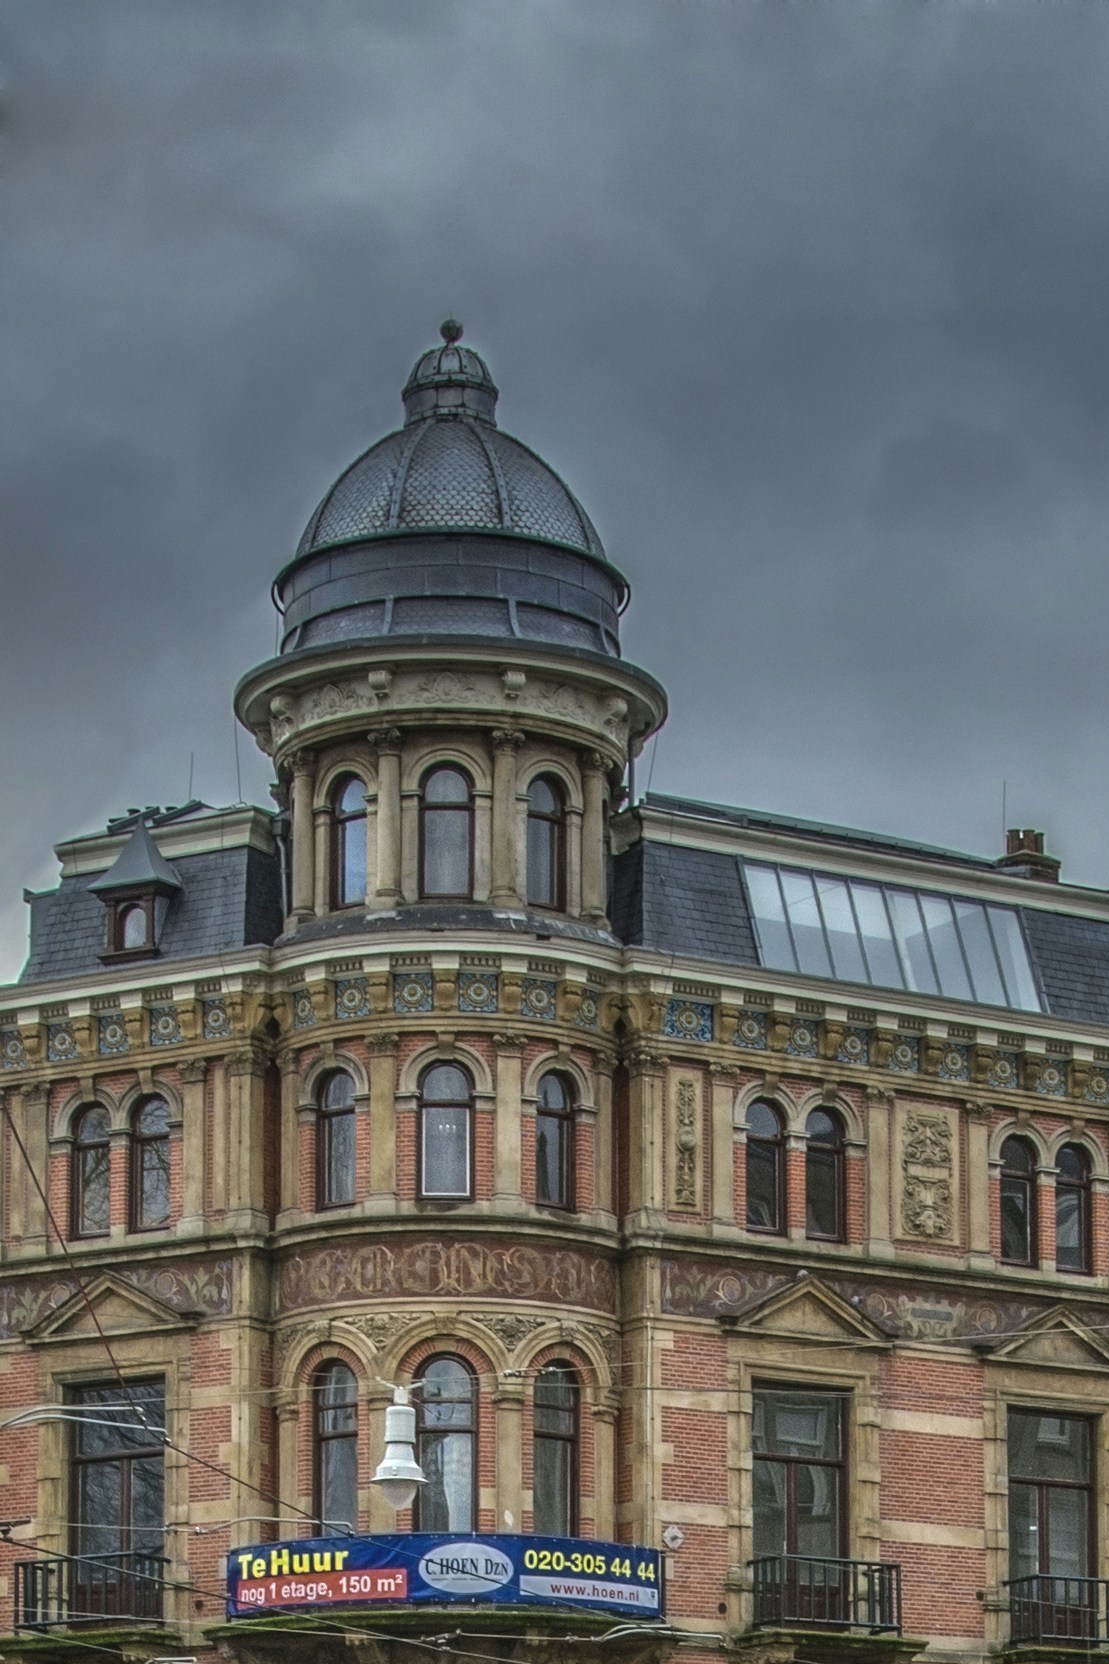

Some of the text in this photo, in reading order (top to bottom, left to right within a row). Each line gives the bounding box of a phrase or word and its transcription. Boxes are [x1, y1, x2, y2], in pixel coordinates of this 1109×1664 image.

[440, 1557, 479, 1575] HOEN
[524, 1549, 656, 1582] 020-305 44 44
[241, 1588, 265, 1604] nog
[269, 1582, 276, 1599] 1
[281, 1581, 332, 1600] etage,
[339, 1575, 371, 1594] 150
[550, 1584, 640, 1601] www.hoen.nl
